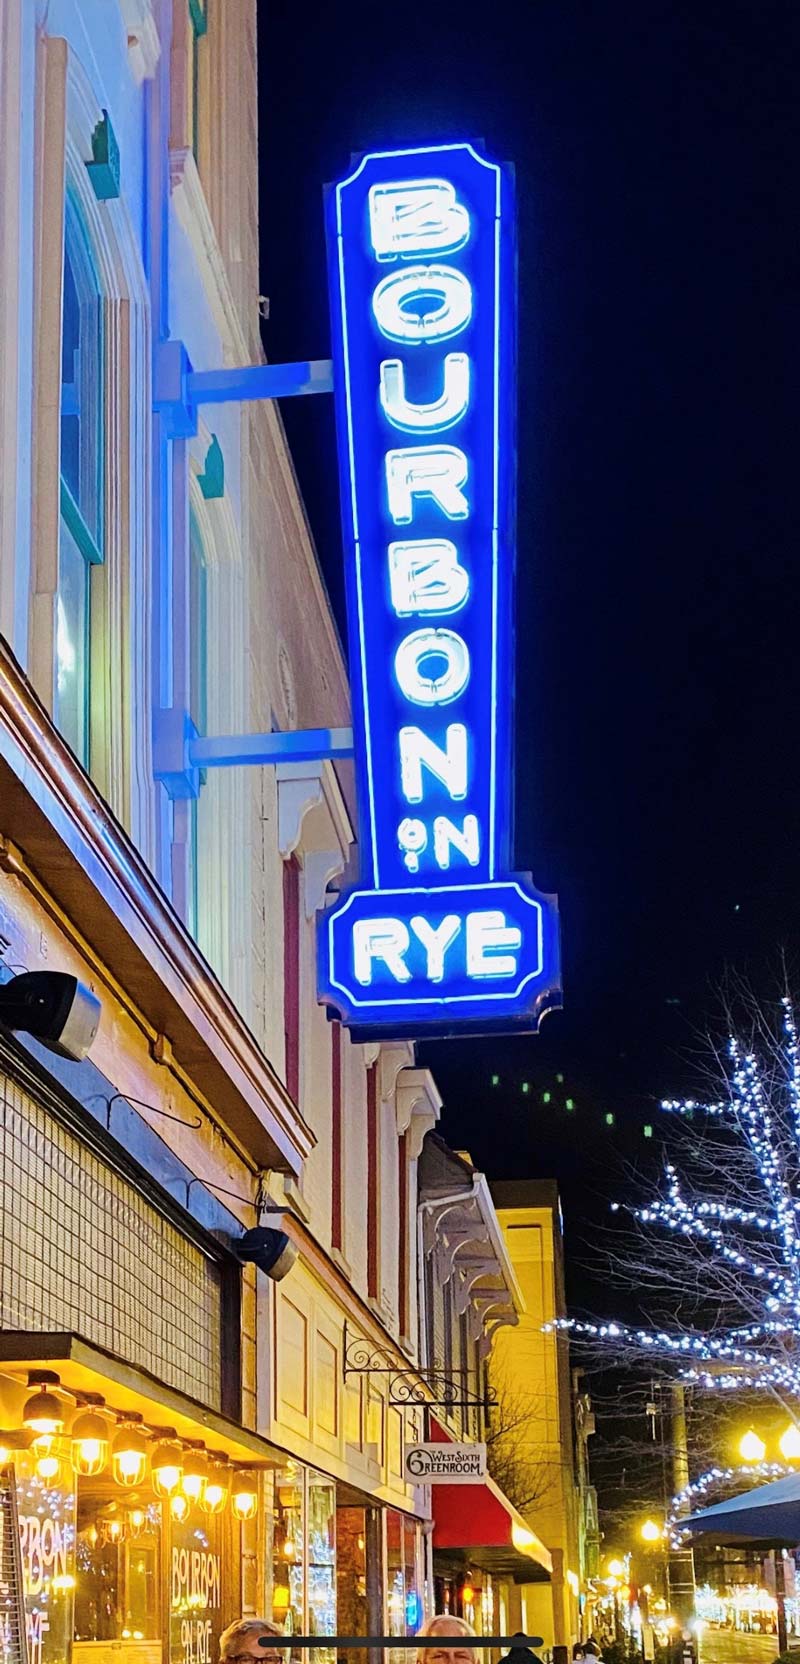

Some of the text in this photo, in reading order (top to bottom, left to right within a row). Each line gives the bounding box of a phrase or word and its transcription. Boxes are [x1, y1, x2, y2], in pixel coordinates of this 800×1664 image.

[368, 178, 473, 804] BOURBON
[397, 814, 480, 874] ON
[352, 910, 522, 986] RYE
[172, 1546, 220, 1609] BOURBON
